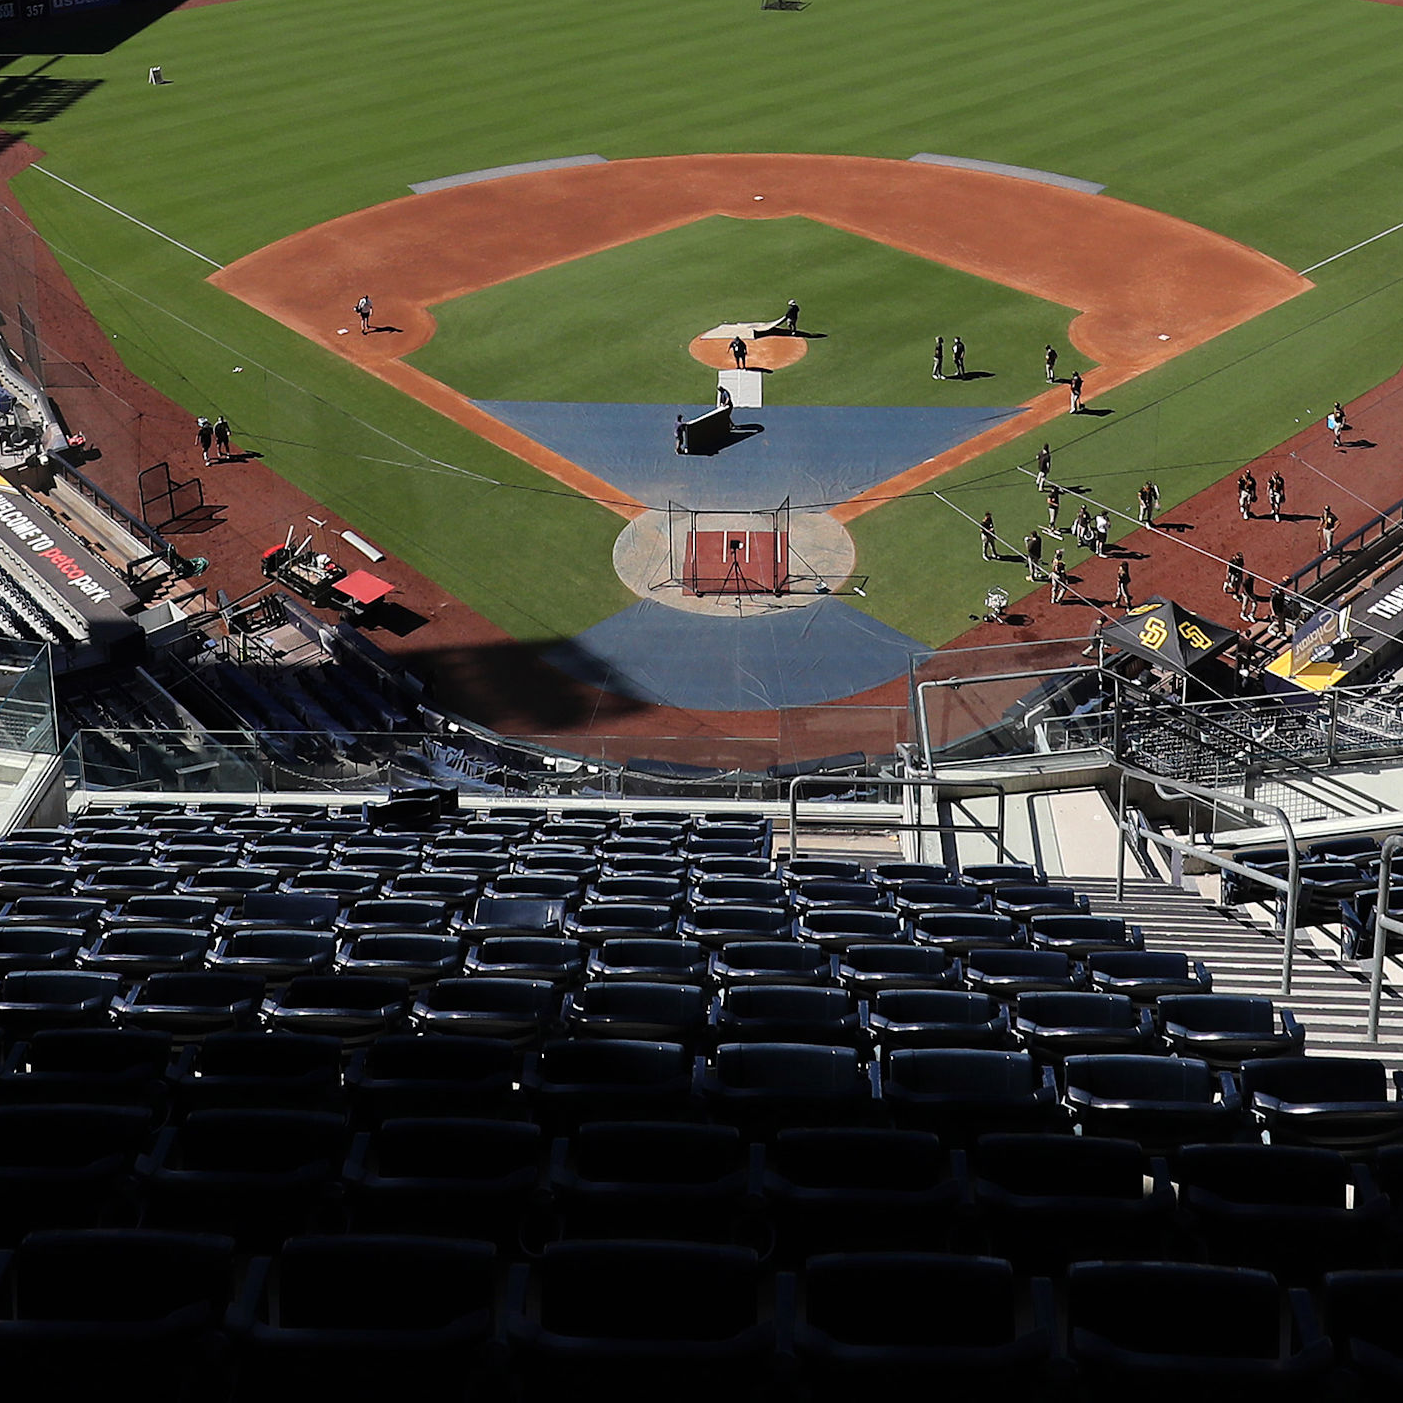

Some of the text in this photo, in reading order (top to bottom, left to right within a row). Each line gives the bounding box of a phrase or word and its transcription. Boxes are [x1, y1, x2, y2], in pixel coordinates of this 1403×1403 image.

[26, 2, 45, 18] 357
[27, 533, 55, 552] TO
[38, 547, 86, 580] petco
[68, 574, 111, 604] park
